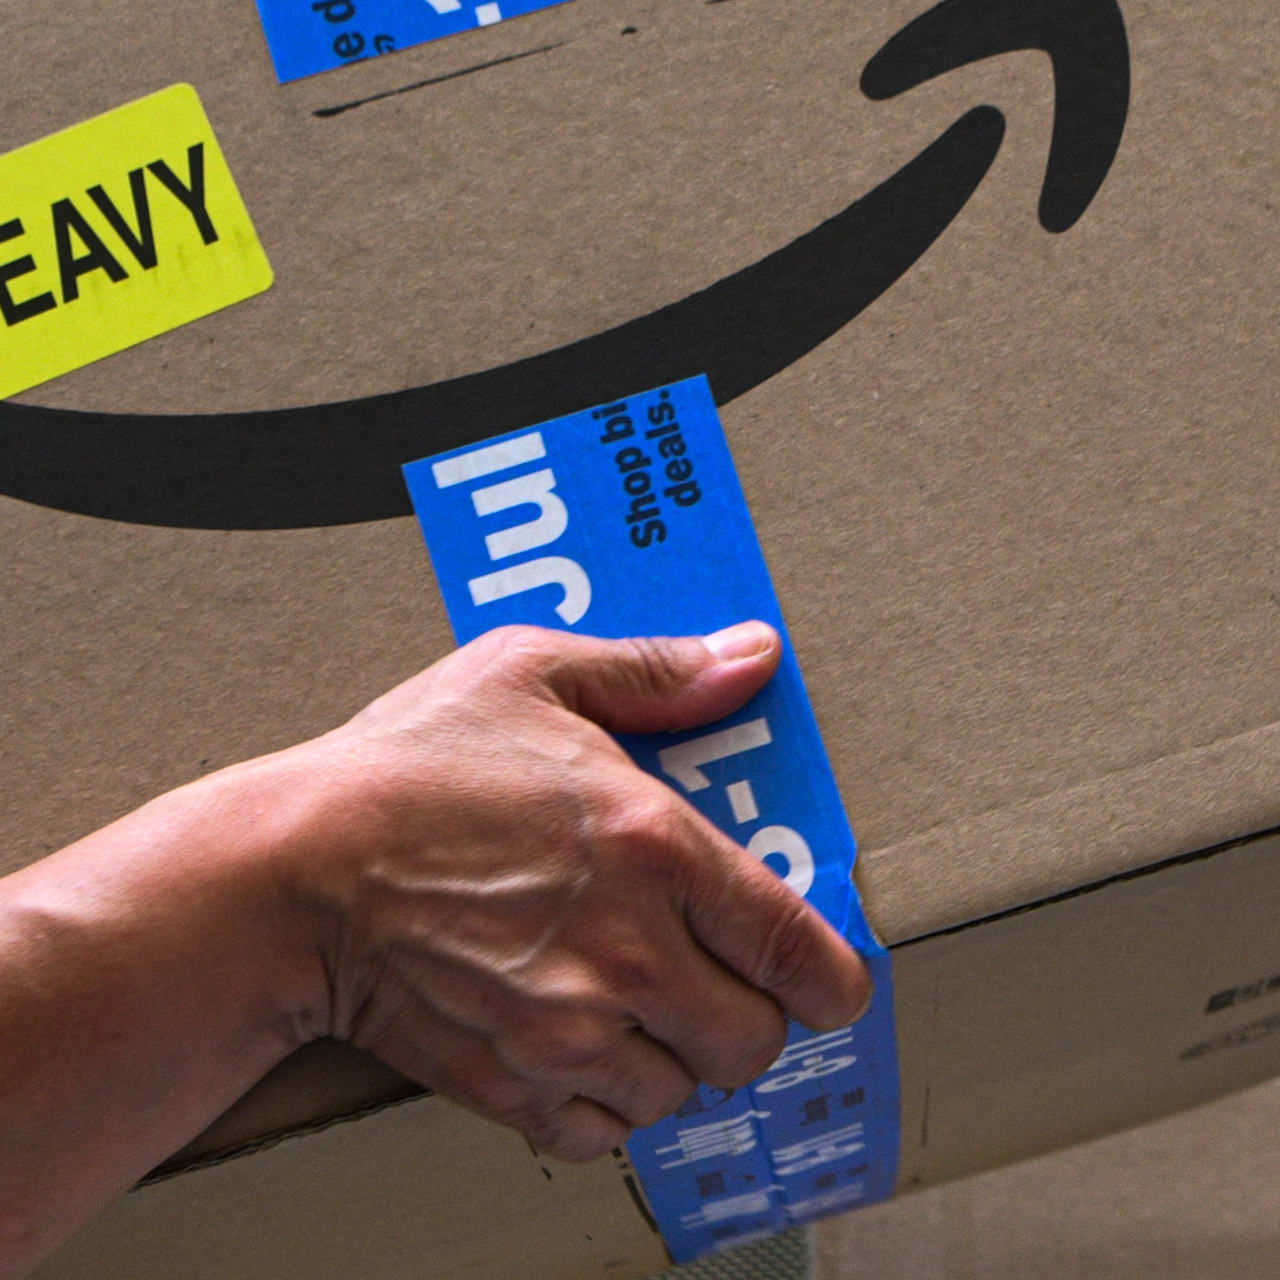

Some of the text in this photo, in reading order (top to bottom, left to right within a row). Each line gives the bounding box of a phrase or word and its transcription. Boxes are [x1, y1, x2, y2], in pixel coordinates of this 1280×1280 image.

[591, 402, 667, 548] Shop bi
[645, 389, 702, 507] deals.
[431, 431, 592, 625] Jul
